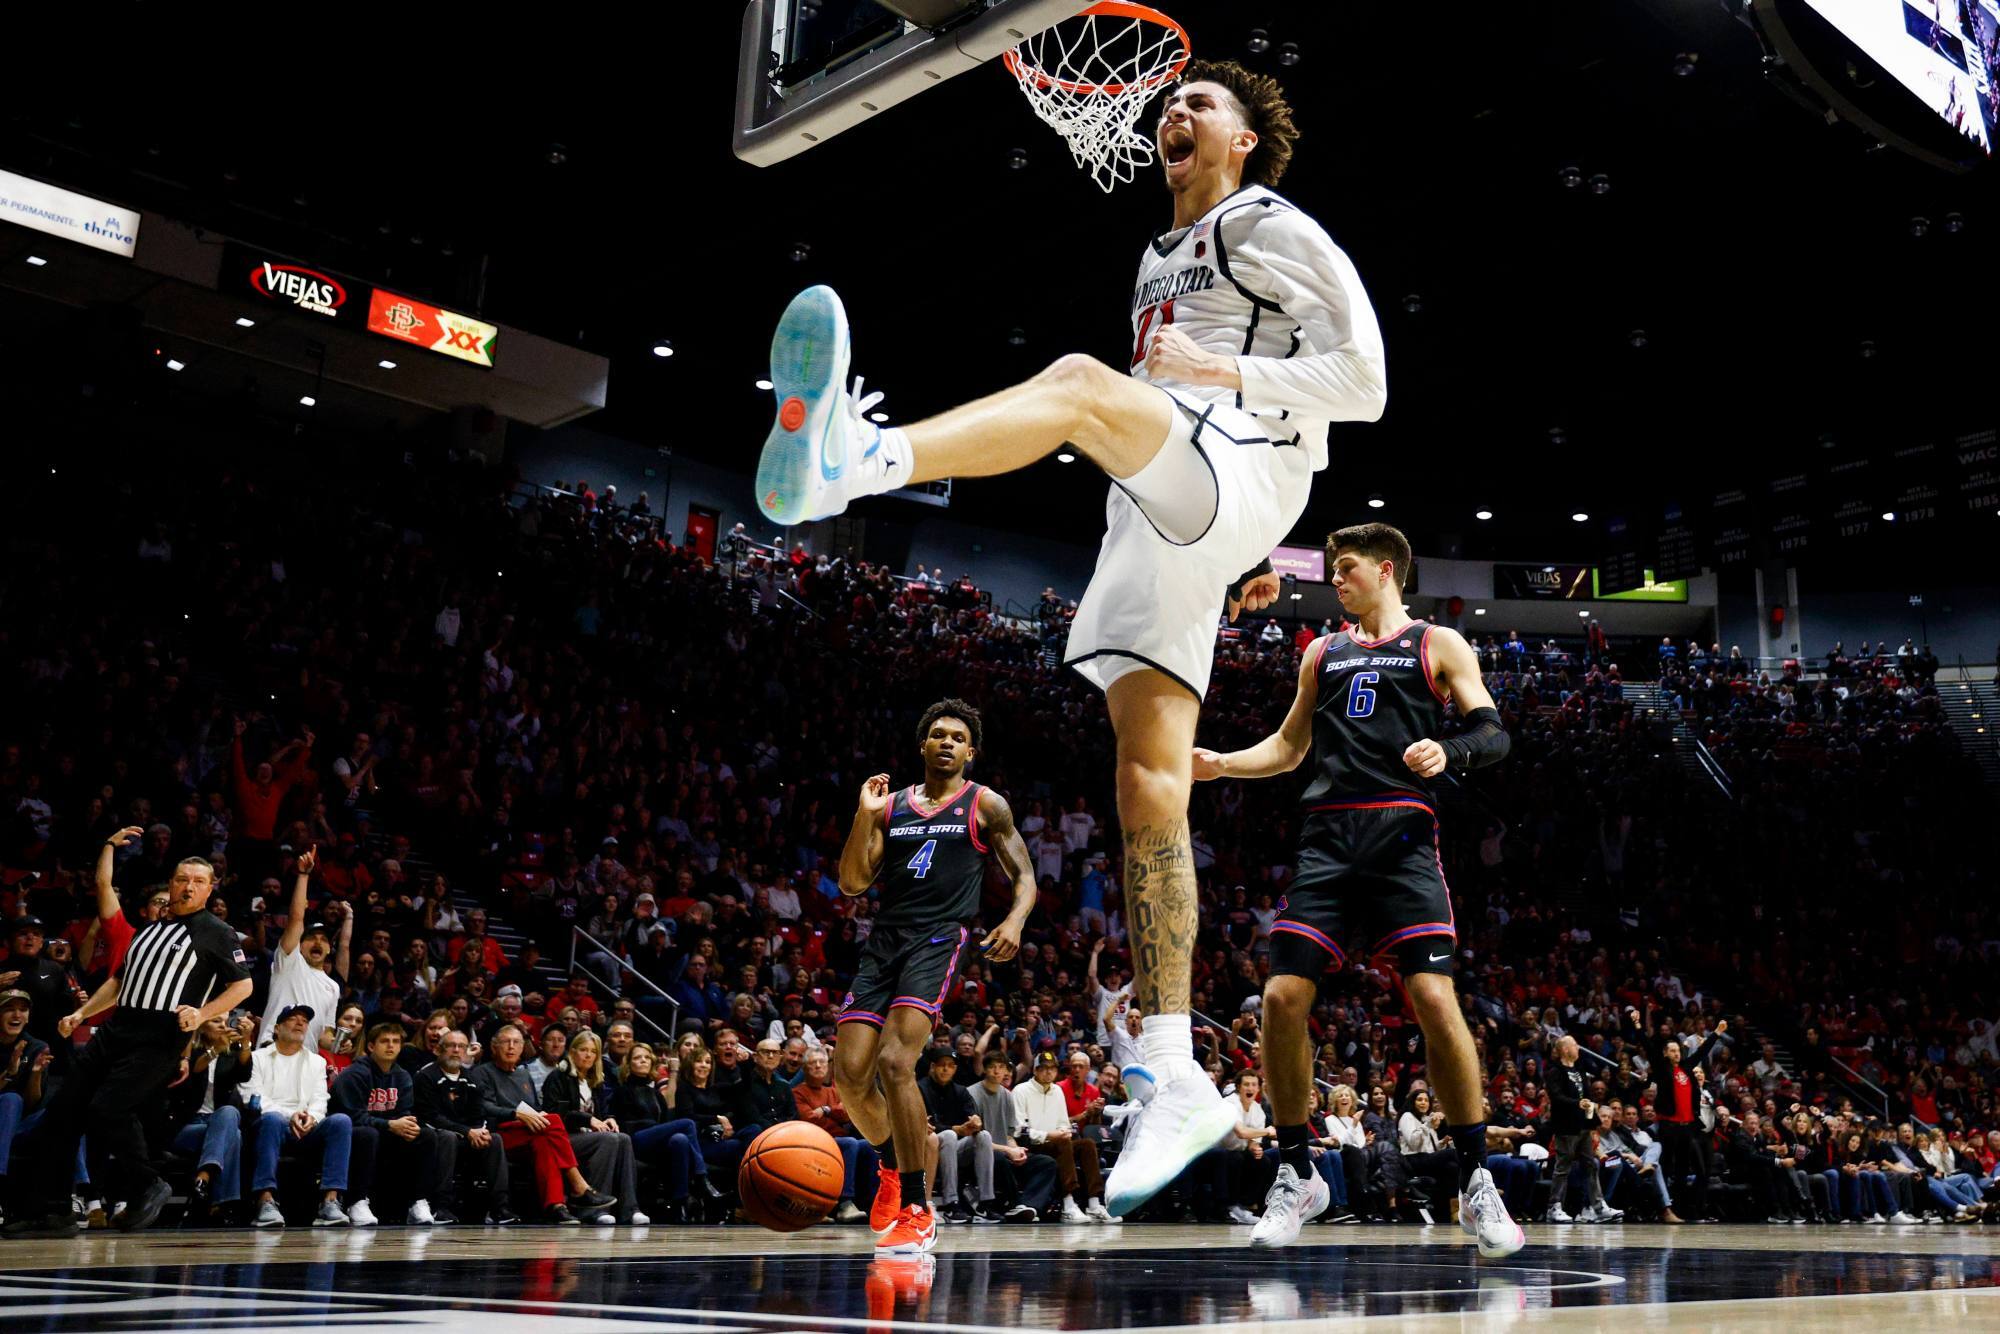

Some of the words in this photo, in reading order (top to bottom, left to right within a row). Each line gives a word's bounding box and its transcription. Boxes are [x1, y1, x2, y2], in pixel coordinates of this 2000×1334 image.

[84, 221, 133, 245] thrive
[263, 261, 334, 307] VIEJAS
[1139, 273, 1175, 308] DIEGO
[1172, 265, 1215, 297] STATE
[300, 300, 337, 317] arena
[446, 327, 483, 354] XX
[1958, 446, 1998, 465] WAC
[1841, 521, 1869, 536] 1977
[1721, 549, 1746, 564] 1941
[1524, 570, 1561, 585] VIEJAS
[1326, 657, 1365, 672] BOISE
[1370, 657, 1417, 667] STATE
[1346, 672, 1379, 718] 6
[889, 826, 925, 837] BOISE
[929, 824, 966, 834] STATE
[907, 839, 937, 878] 4
